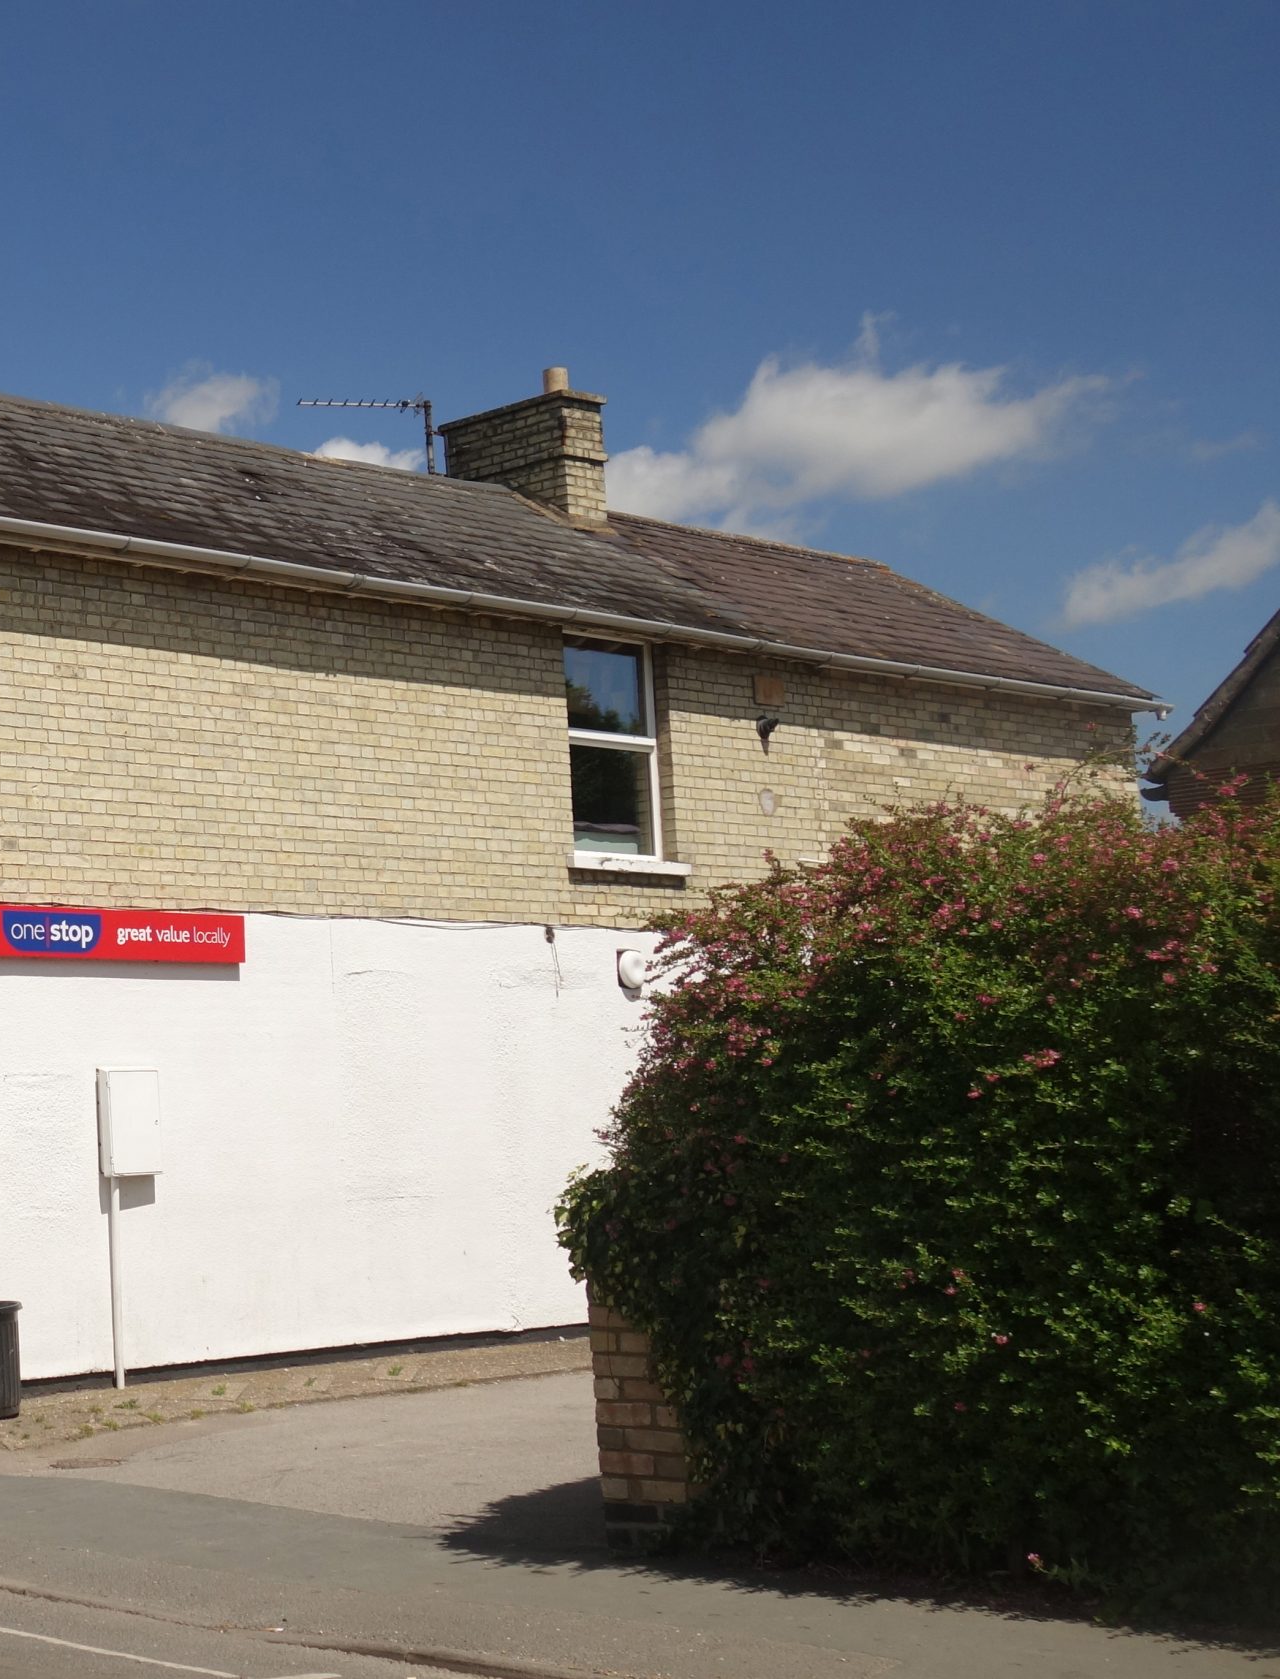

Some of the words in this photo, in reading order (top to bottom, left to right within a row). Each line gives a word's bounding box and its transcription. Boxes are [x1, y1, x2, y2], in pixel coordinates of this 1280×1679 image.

[10, 922, 45, 941] one
[50, 920, 94, 949] stop
[116, 926, 153, 945] great
[156, 925, 190, 943] value
[193, 926, 231, 948] locally
